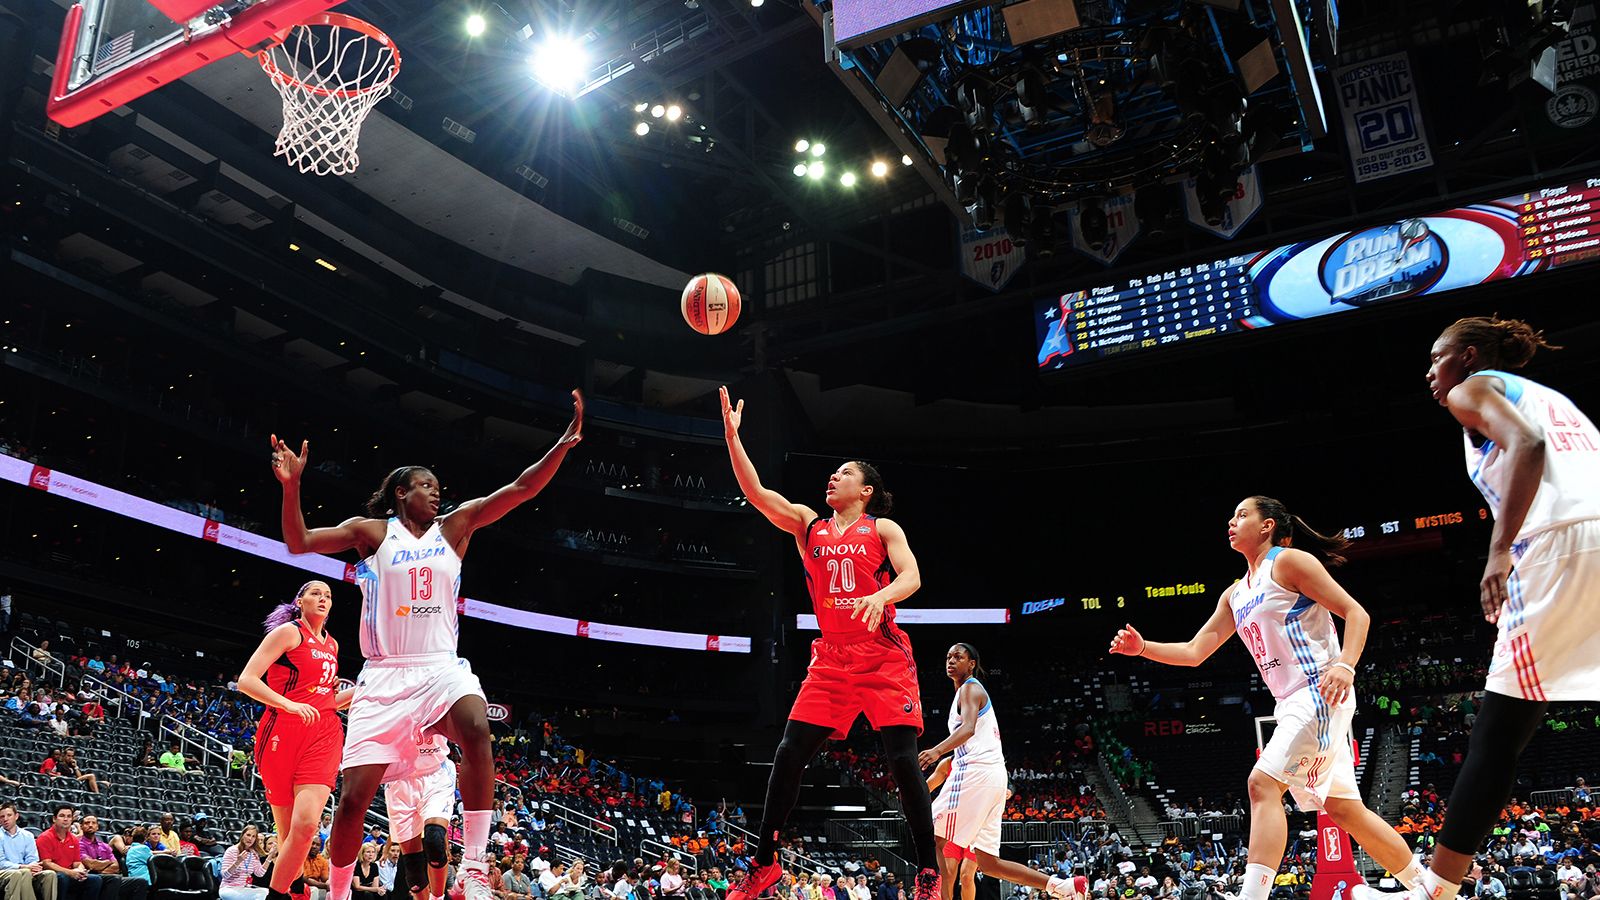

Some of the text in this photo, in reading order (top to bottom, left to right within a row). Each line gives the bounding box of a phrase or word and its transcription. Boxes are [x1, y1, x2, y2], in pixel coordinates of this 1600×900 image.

[1337, 59, 1406, 85] WIDESPREAD
[1341, 71, 1411, 107] PANIC
[1360, 106, 1413, 148] 20
[1357, 143, 1424, 165] SOLD OUT SHOWS
[1359, 151, 1426, 176] 1999-2013
[974, 238, 1012, 261] 2010
[1344, 232, 1399, 265] RUN
[1333, 240, 1432, 298] DREAM
[1092, 285, 1114, 297] Player
[1547, 432, 1598, 452] LYTTL
[1380, 520, 1400, 534] 1ST
[1414, 512, 1463, 529] MYSTICS
[821, 544, 867, 556] INOVA
[408, 567, 432, 600] 13
[827, 558, 856, 593] 20
[412, 605, 441, 613] boost
[835, 597, 856, 605] boo
[1022, 582, 1206, 614] DREAM TOL 3 Team Fouls
[1236, 593, 1265, 628] DREAM
[126, 639, 140, 649] 105
[1243, 622, 1266, 659] 23
[318, 651, 337, 663] INOV
[320, 661, 336, 684] 31
[488, 706, 504, 718] KIA
[1143, 720, 1184, 736] RED
